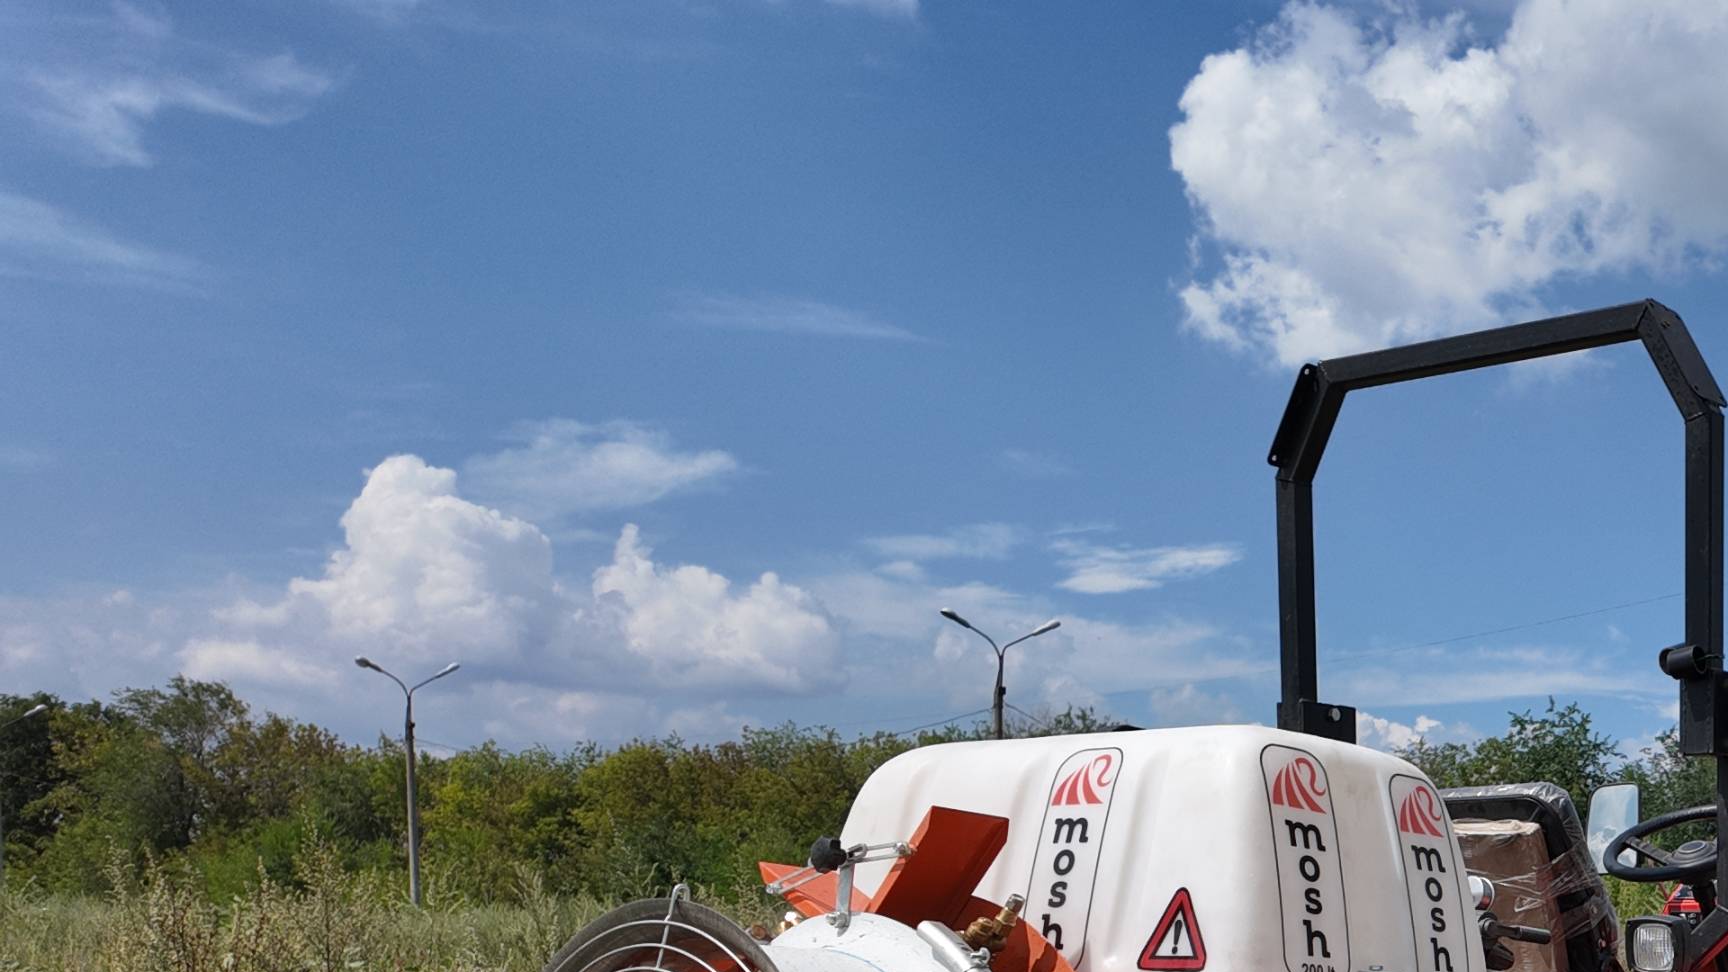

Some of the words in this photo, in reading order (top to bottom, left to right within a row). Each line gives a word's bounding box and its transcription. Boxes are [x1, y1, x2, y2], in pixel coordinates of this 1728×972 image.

[1041, 816, 1089, 950] mosh
[1285, 819, 1331, 958] mosh
[1411, 845, 1454, 972] mosh
